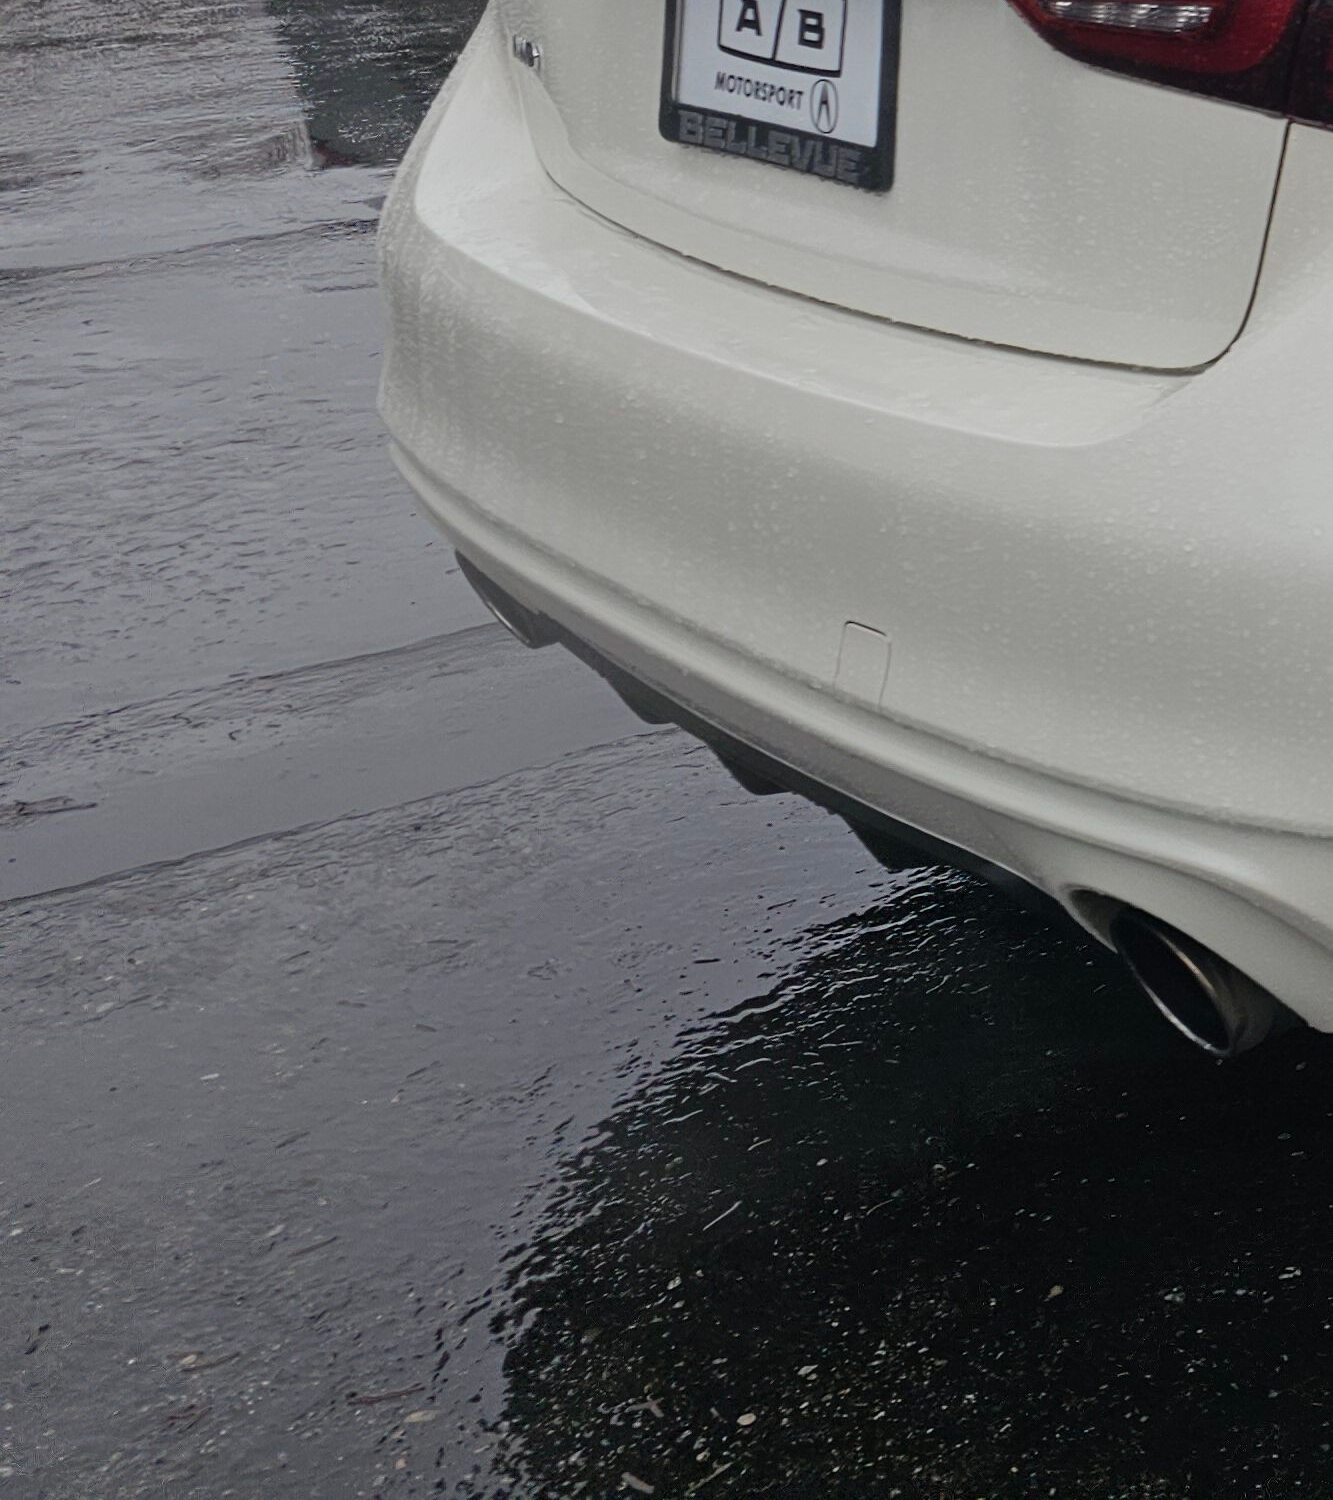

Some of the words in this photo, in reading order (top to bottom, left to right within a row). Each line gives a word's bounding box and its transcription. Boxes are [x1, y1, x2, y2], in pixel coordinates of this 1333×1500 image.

[797, 8, 827, 50] B
[714, 71, 805, 111] MOTORSPORT
[678, 108, 868, 186] BELLEVUE
